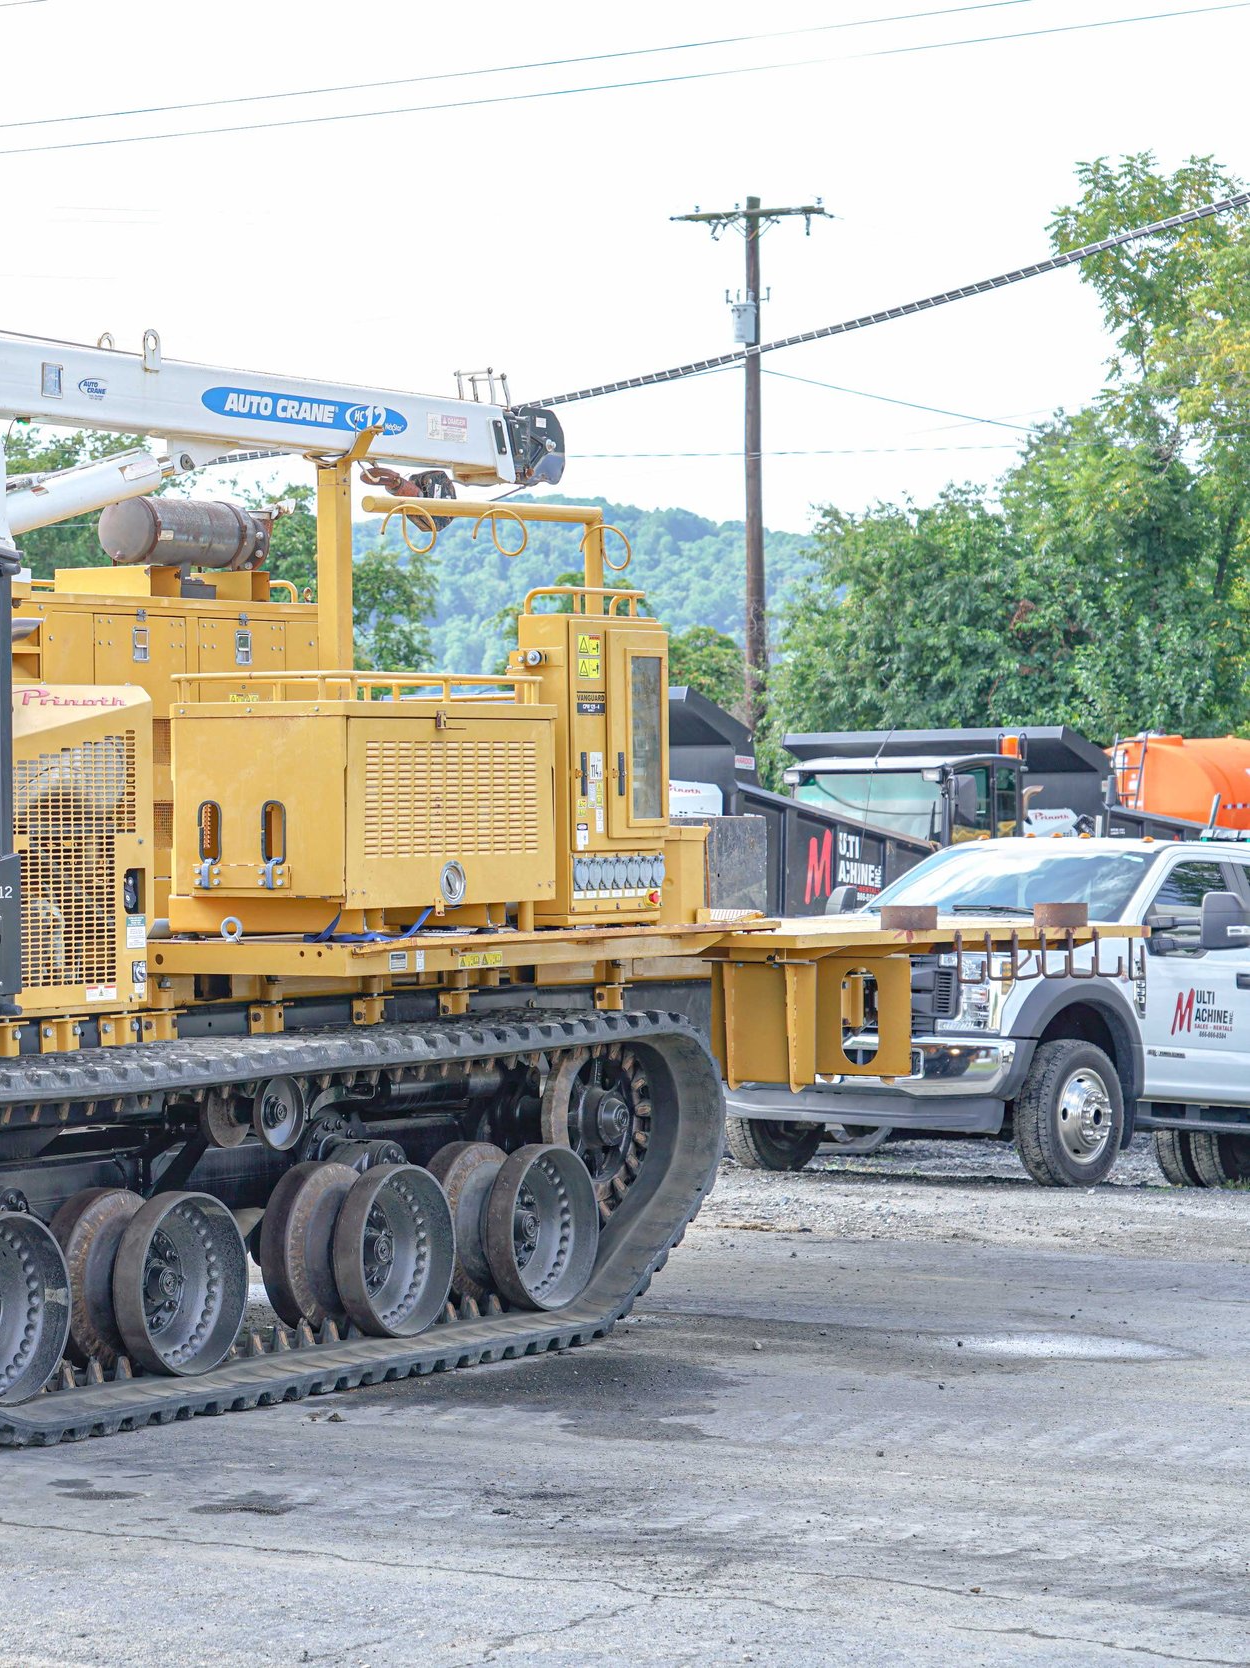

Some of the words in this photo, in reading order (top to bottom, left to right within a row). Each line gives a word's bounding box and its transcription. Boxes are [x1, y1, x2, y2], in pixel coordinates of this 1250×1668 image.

[86, 387, 107, 395] CRANE
[224, 392, 273, 417] AUTO
[276, 398, 335, 424] CRANE
[354, 410, 365, 423] HC
[365, 405, 387, 428] 12
[12, 689, 127, 706] Prinoth
[576, 694, 605, 702] VANGUARD
[669, 783, 701, 795] rinoth
